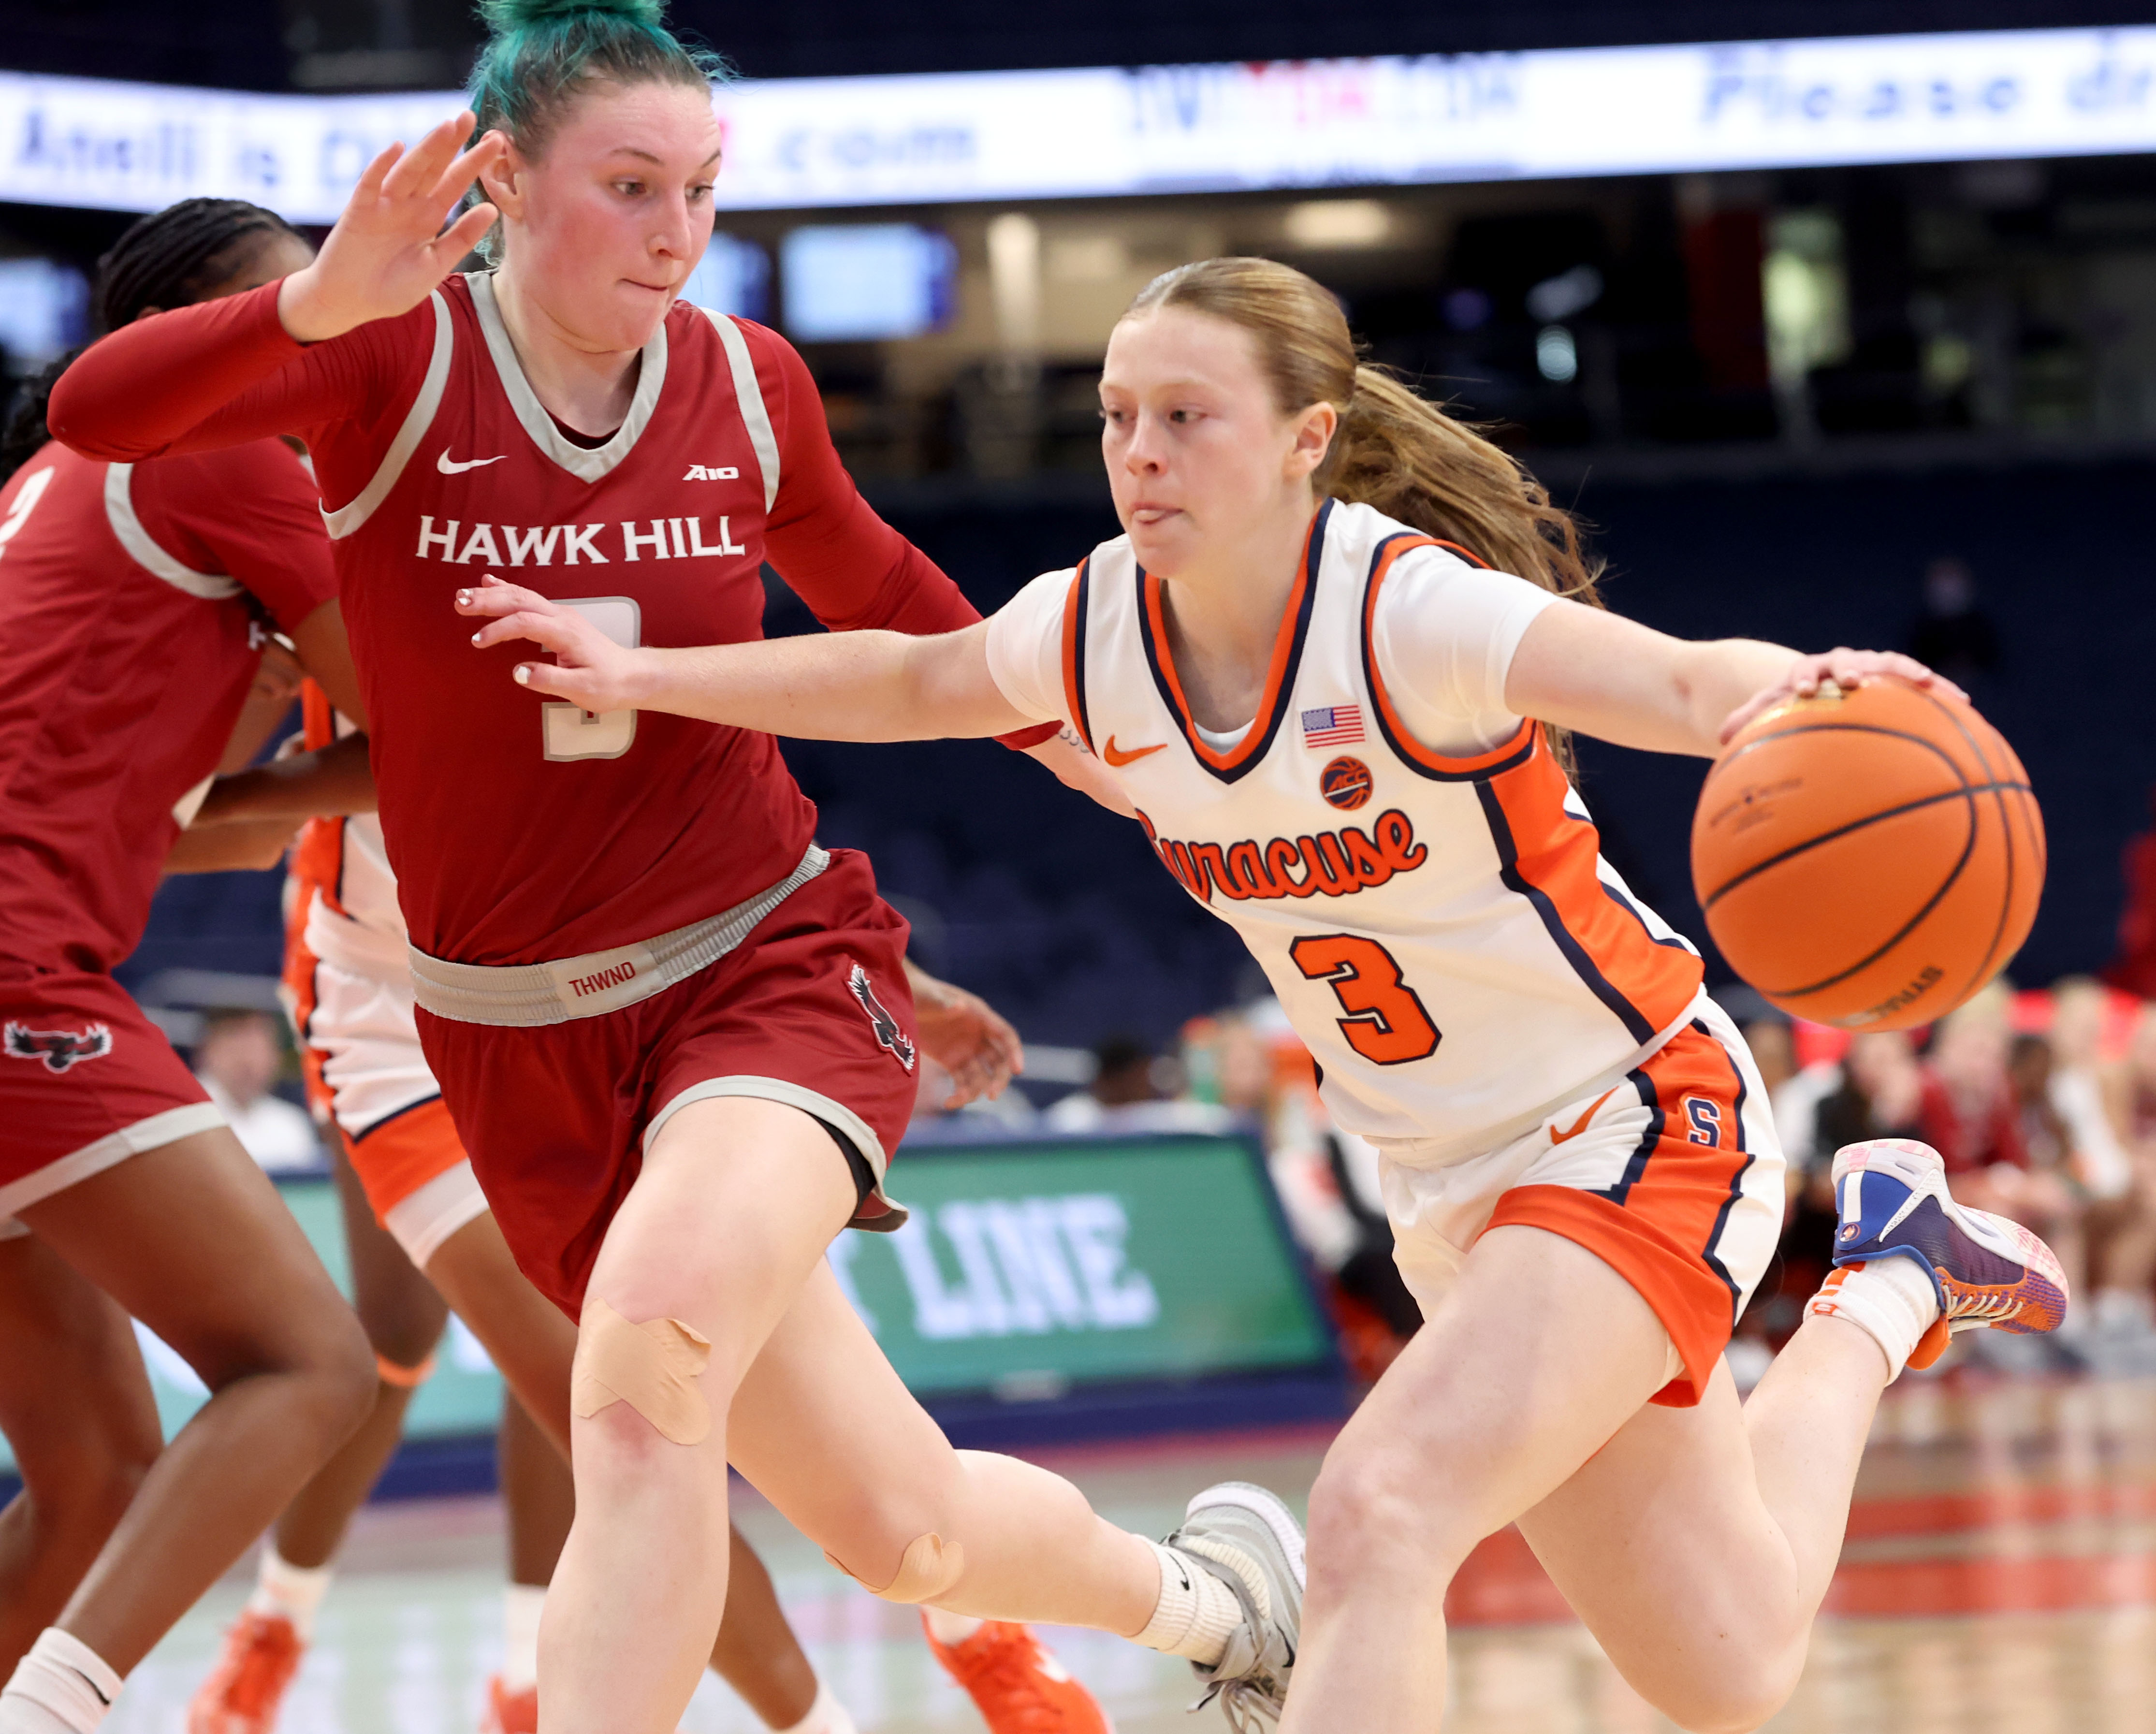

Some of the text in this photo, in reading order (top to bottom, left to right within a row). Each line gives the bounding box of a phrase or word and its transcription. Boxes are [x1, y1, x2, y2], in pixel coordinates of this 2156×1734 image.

[682, 464, 740, 481] A10
[415, 515, 745, 567] HAWK HILL
[1326, 770, 1369, 793] ACC
[568, 961, 636, 997] THWND
[1288, 933, 1442, 1066] 3
[1684, 1096, 1721, 1149] S
